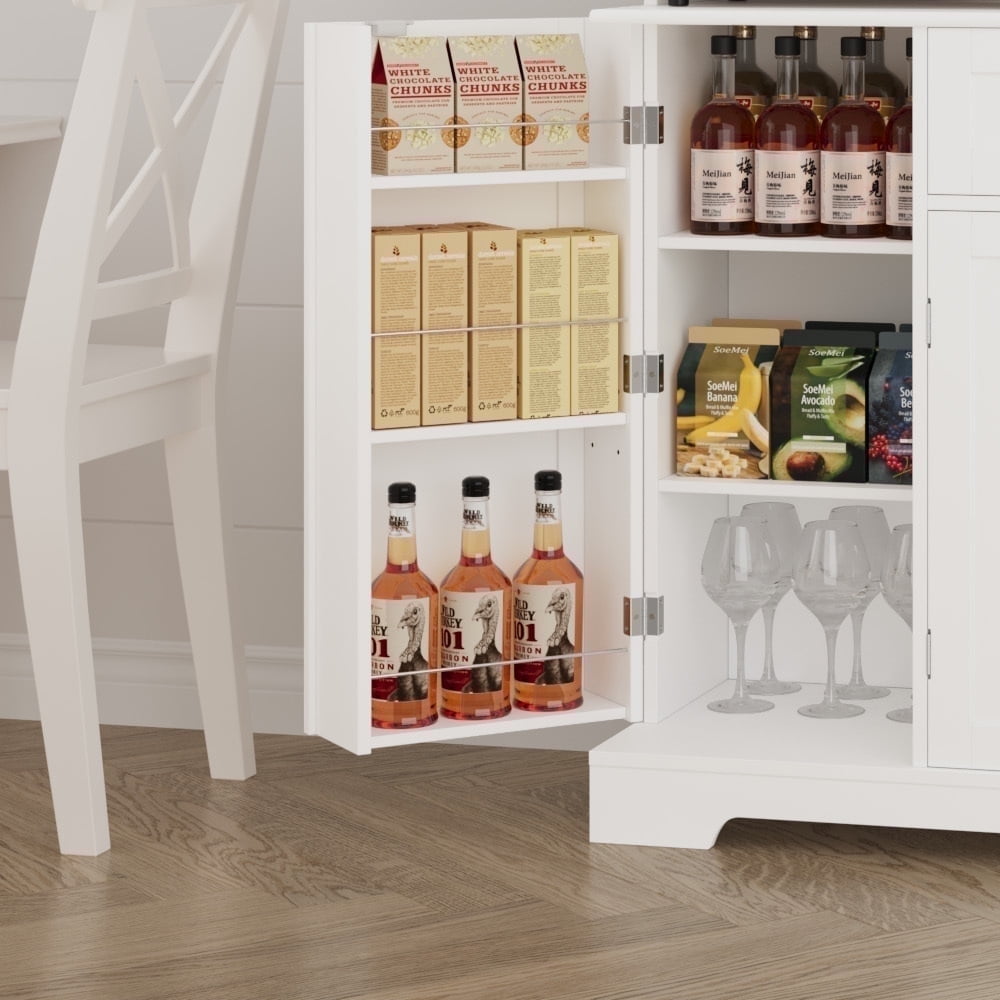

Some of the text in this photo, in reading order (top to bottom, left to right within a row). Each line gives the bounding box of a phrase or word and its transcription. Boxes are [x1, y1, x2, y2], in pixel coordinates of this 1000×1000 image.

[389, 68, 431, 77] WHITE
[457, 67, 499, 75] WHITE
[526, 65, 567, 73] WHITE
[460, 75, 520, 83] CHOCOLATE
[528, 73, 587, 81] CHOCOLATE
[390, 85, 452, 95] CHUNKS
[460, 83, 520, 93] CHUNKS
[528, 81, 587, 91] CHUNKS
[702, 169, 732, 178] MeiJian
[766, 171, 796, 179] MeiJian
[832, 172, 862, 181] MeiJian
[713, 346, 749, 354] SoeMei
[808, 349, 845, 357] SoeMei
[707, 380, 738, 392] SoeMei
[803, 383, 834, 395] SoeMei
[707, 391, 738, 402] Banana
[800, 394, 836, 406] Avocado
